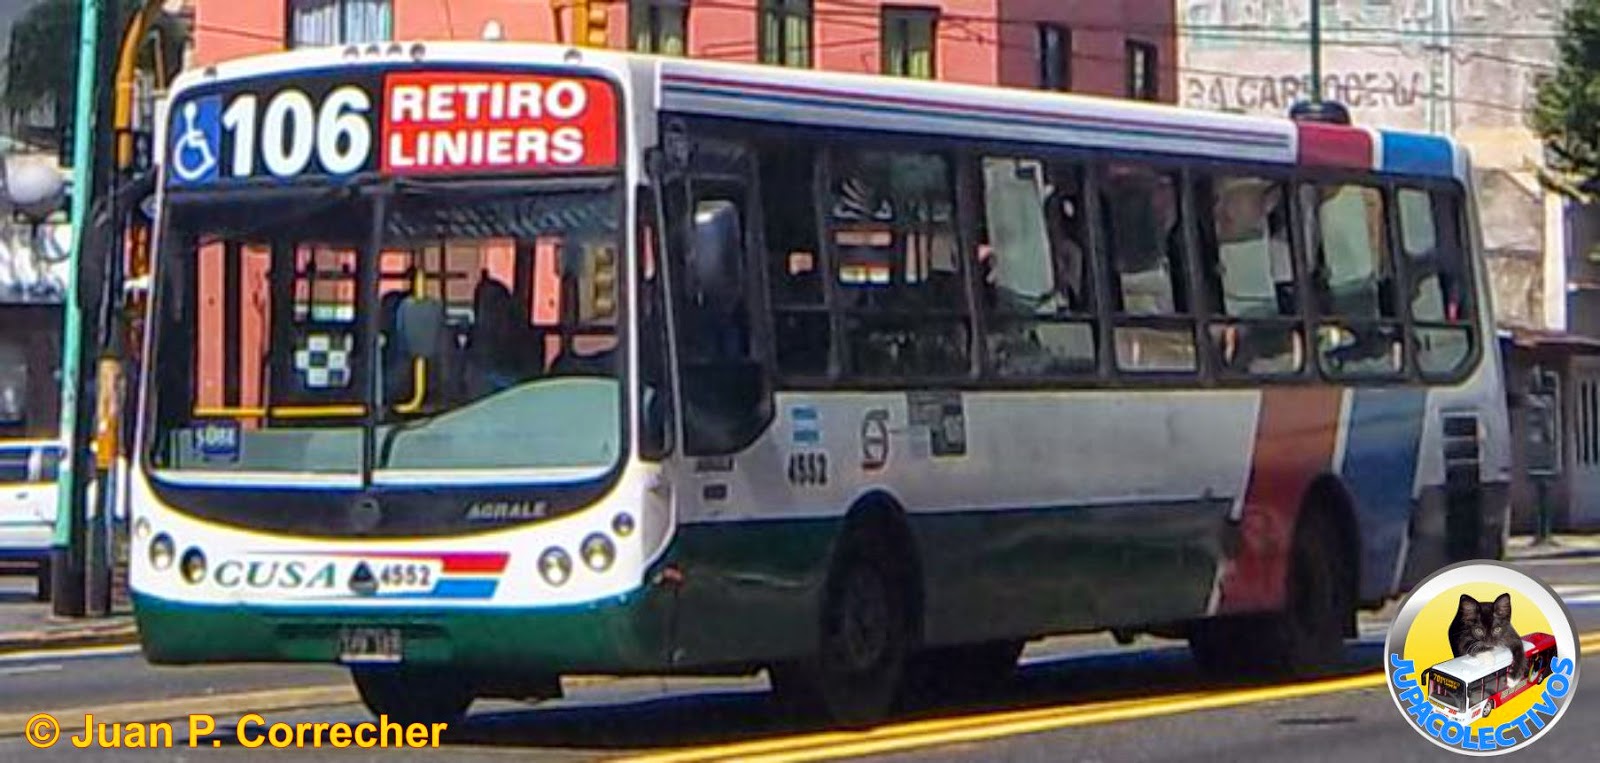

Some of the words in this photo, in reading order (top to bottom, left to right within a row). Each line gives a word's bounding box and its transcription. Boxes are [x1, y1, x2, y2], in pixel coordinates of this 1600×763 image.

[390, 80, 586, 122] RETIRO
[222, 84, 372, 176] 106
[388, 127, 585, 166] LINIERS
[213, 560, 337, 588] CUSA
[380, 564, 431, 586] 4552
